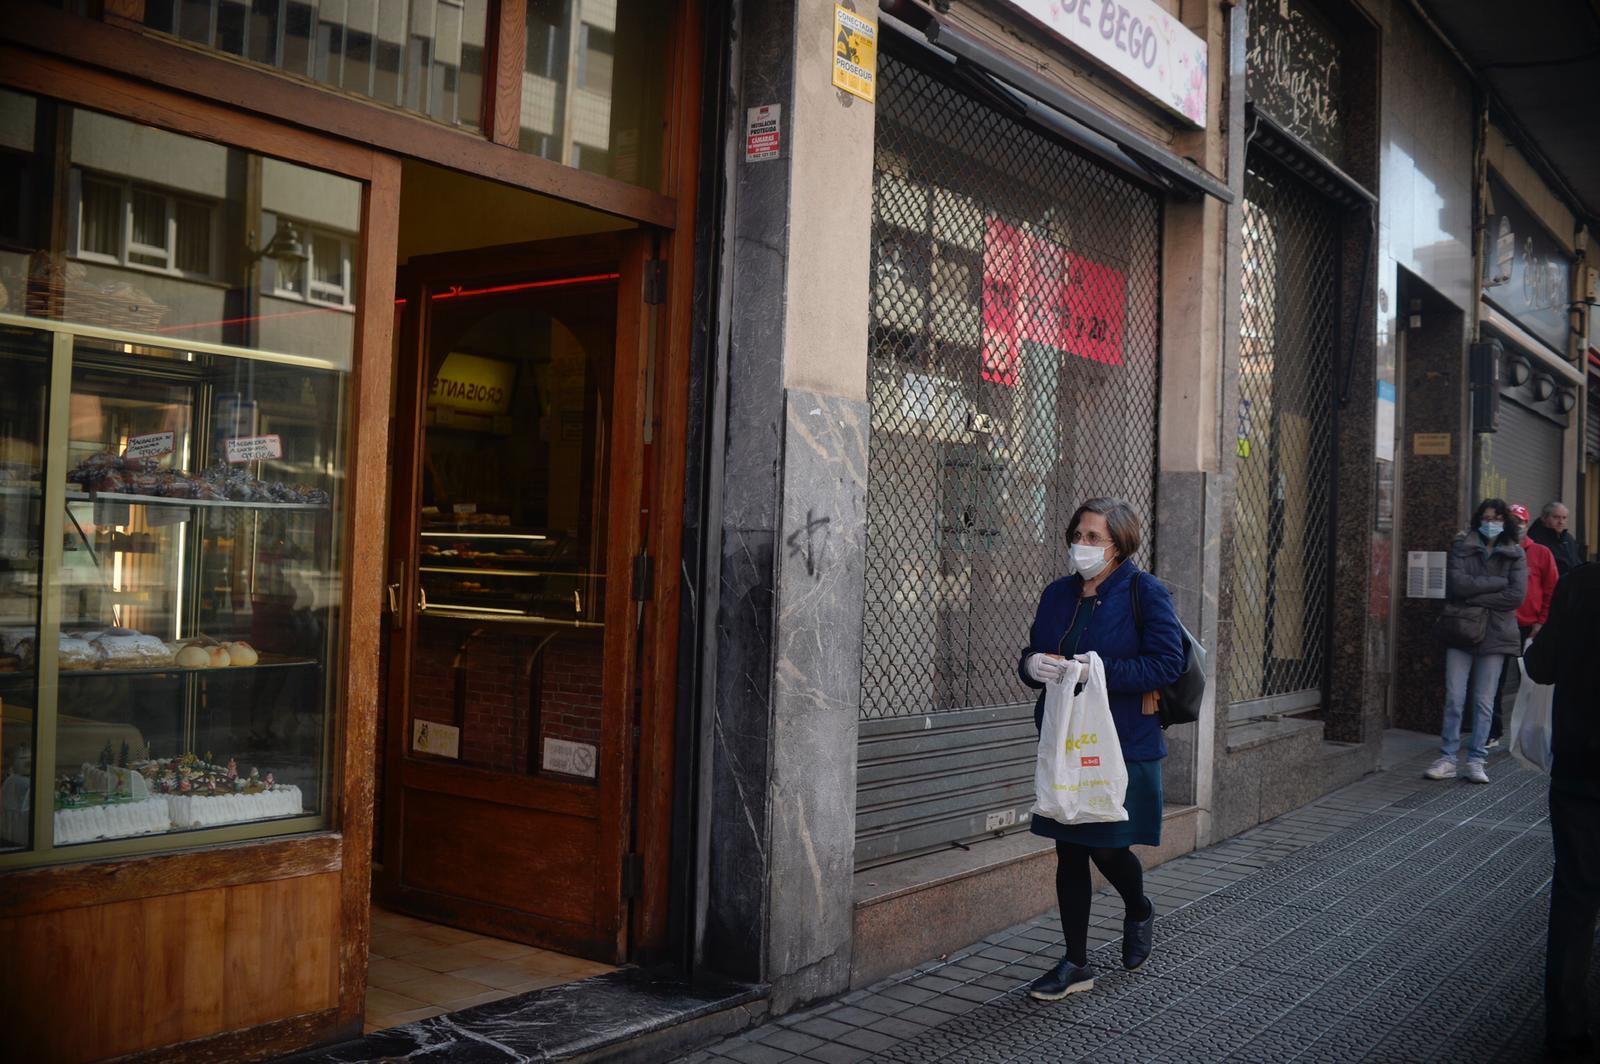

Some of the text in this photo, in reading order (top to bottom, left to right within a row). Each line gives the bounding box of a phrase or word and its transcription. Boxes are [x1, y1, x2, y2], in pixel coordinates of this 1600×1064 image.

[837, 10, 874, 34] CONECTADA
[1099, 0, 1157, 69] BEGO
[836, 58, 873, 82] PROSEGUR
